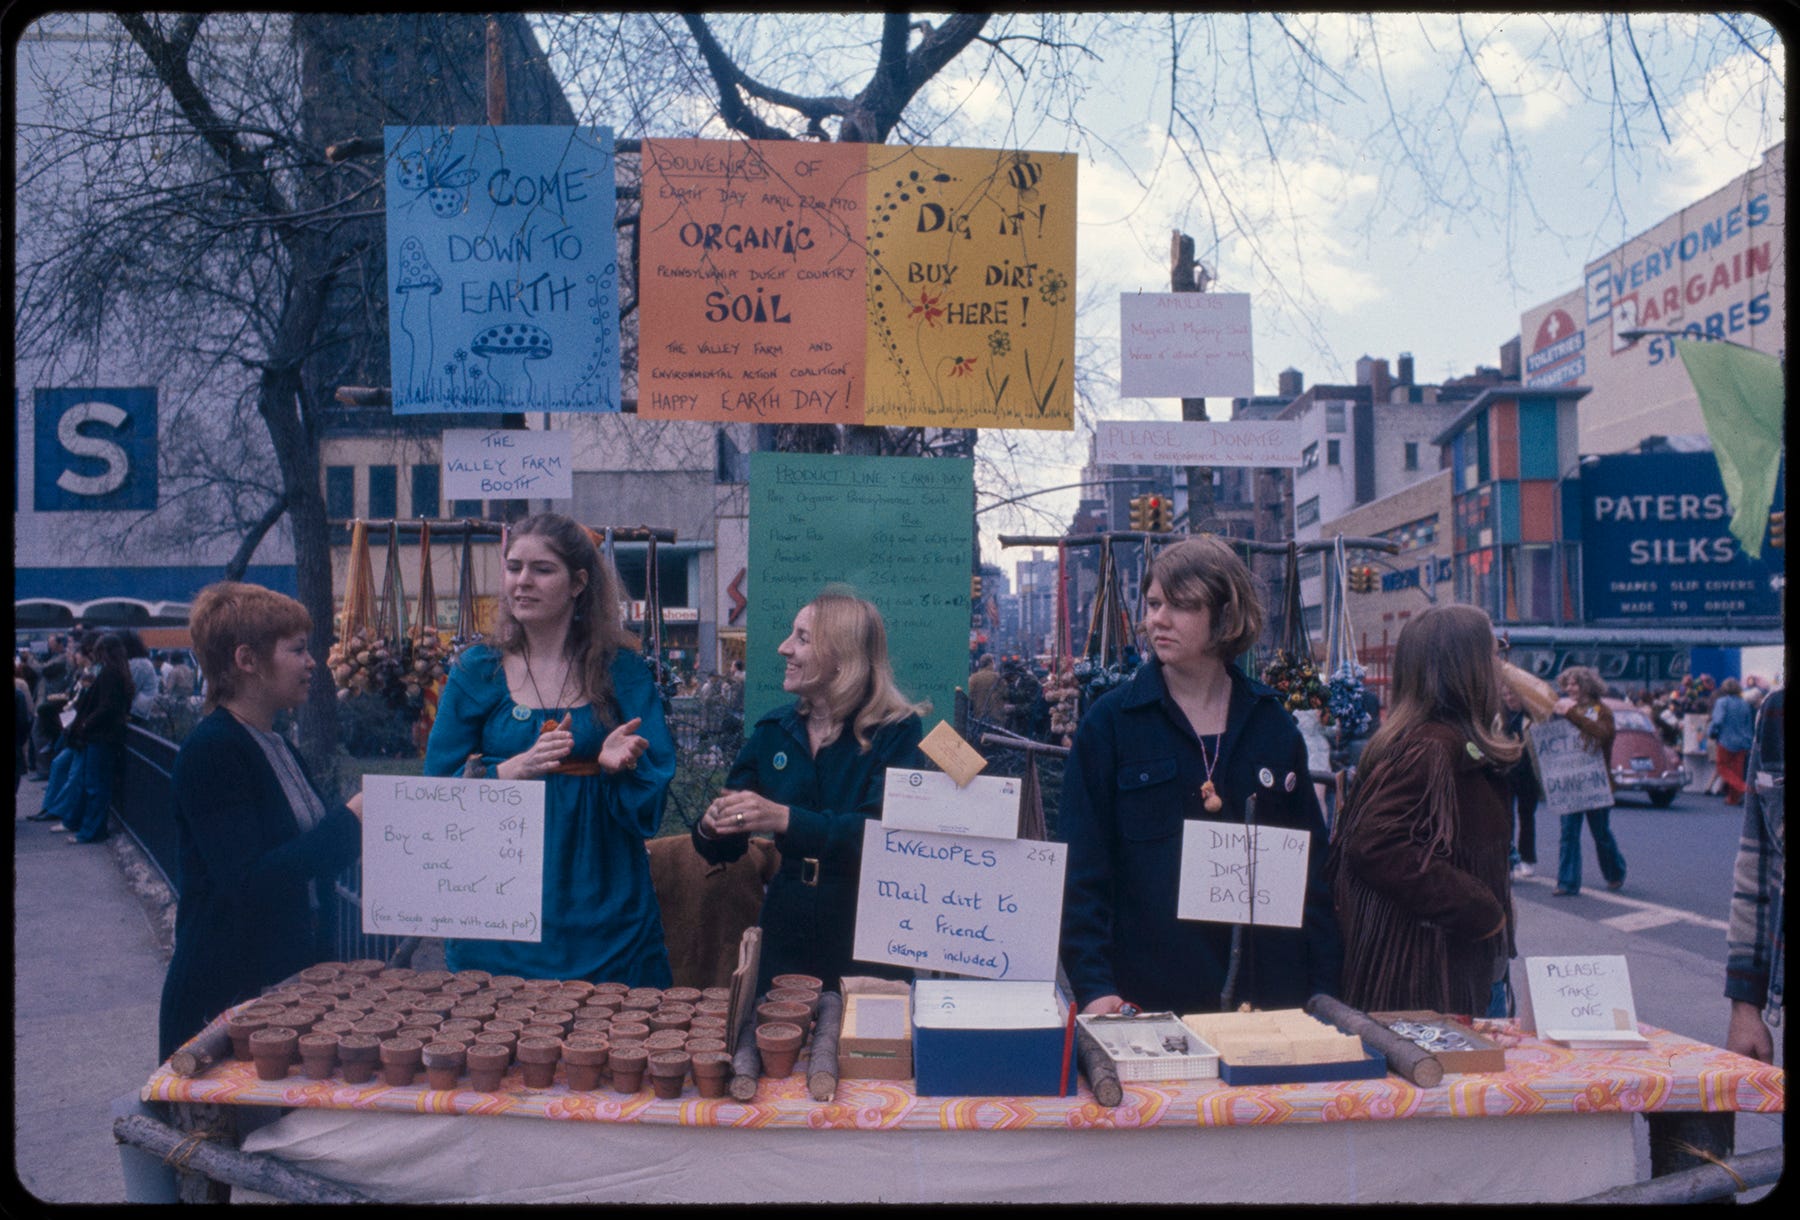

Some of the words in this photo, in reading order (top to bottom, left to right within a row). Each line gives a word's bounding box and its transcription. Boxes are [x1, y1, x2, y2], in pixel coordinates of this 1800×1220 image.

[794, 160, 823, 177] OF
[487, 168, 588, 215] COME
[658, 186, 708, 204] EARTH
[719, 187, 749, 208] DAY
[762, 193, 794, 212] APRIL
[448, 225, 538, 263] DOWN
[541, 225, 583, 261] TO
[679, 220, 815, 254] ORGANIC
[1585, 193, 1772, 327] EVERYONES
[656, 265, 740, 281] PENNSYLVANIA
[750, 266, 787, 281] DUTCH
[796, 266, 857, 282] COUNTRY
[908, 262, 958, 285] BUY
[985, 259, 1039, 288] DIRT
[461, 273, 577, 318] EARTH
[705, 287, 791, 324] SOIL
[1610, 241, 1772, 358] BARGAIN
[665, 342, 688, 354] THE
[697, 341, 741, 355] VALLEY
[753, 344, 784, 358] FARM
[808, 342, 833, 352] AND
[652, 366, 734, 381] ENVIRONMENTAL
[742, 367, 778, 380] ACTION
[790, 361, 850, 379] COALITION
[651, 392, 700, 412] HAPPY
[720, 386, 781, 417] EARTH
[56, 401, 129, 496] S
[480, 431, 515, 448] THE
[1108, 427, 1181, 447] PLEASE
[1210, 427, 1284, 447] DONATE
[447, 459, 507, 476] VALLEY
[522, 454, 562, 477] FARM
[776, 463, 842, 482] PRODUCT
[852, 470, 884, 484] LINE
[481, 475, 540, 493] BOOTH
[1595, 494, 1734, 521] PATERS
[1630, 538, 1735, 565] SILKS
[1611, 581, 1658, 592] DRAPES
[1671, 581, 1699, 591] SLIP
[1705, 580, 1755, 591] COVERS
[1621, 602, 1655, 613] MADE
[1672, 601, 1688, 611] TO
[1704, 601, 1745, 611] ORDER
[478, 784, 523, 806] POTS
[384, 824, 414, 855] Buy
[422, 832, 434, 842] a
[445, 823, 476, 842] Pot
[885, 829, 997, 868] ENVELOPES
[1026, 847, 1057, 867] 25¢
[1208, 828, 1270, 854] DIME
[1282, 833, 1306, 854] 10¢
[423, 858, 453, 871] and
[1208, 860, 1259, 886] DIRT
[438, 874, 488, 894] Plant
[495, 876, 517, 895] it
[877, 880, 929, 904] Mail
[941, 889, 982, 911] dirt
[998, 893, 1018, 914] to
[1209, 886, 1272, 905] BAGS
[459, 914, 482, 927] with
[484, 917, 509, 931] each
[511, 911, 538, 937] pot)
[899, 918, 913, 931] a
[887, 939, 929, 961] (stamps
[943, 949, 1010, 979] included)
[1546, 962, 1608, 978] PLEASE
[1557, 984, 1599, 998] TAKE
[1571, 1003, 1603, 1018] ONE
